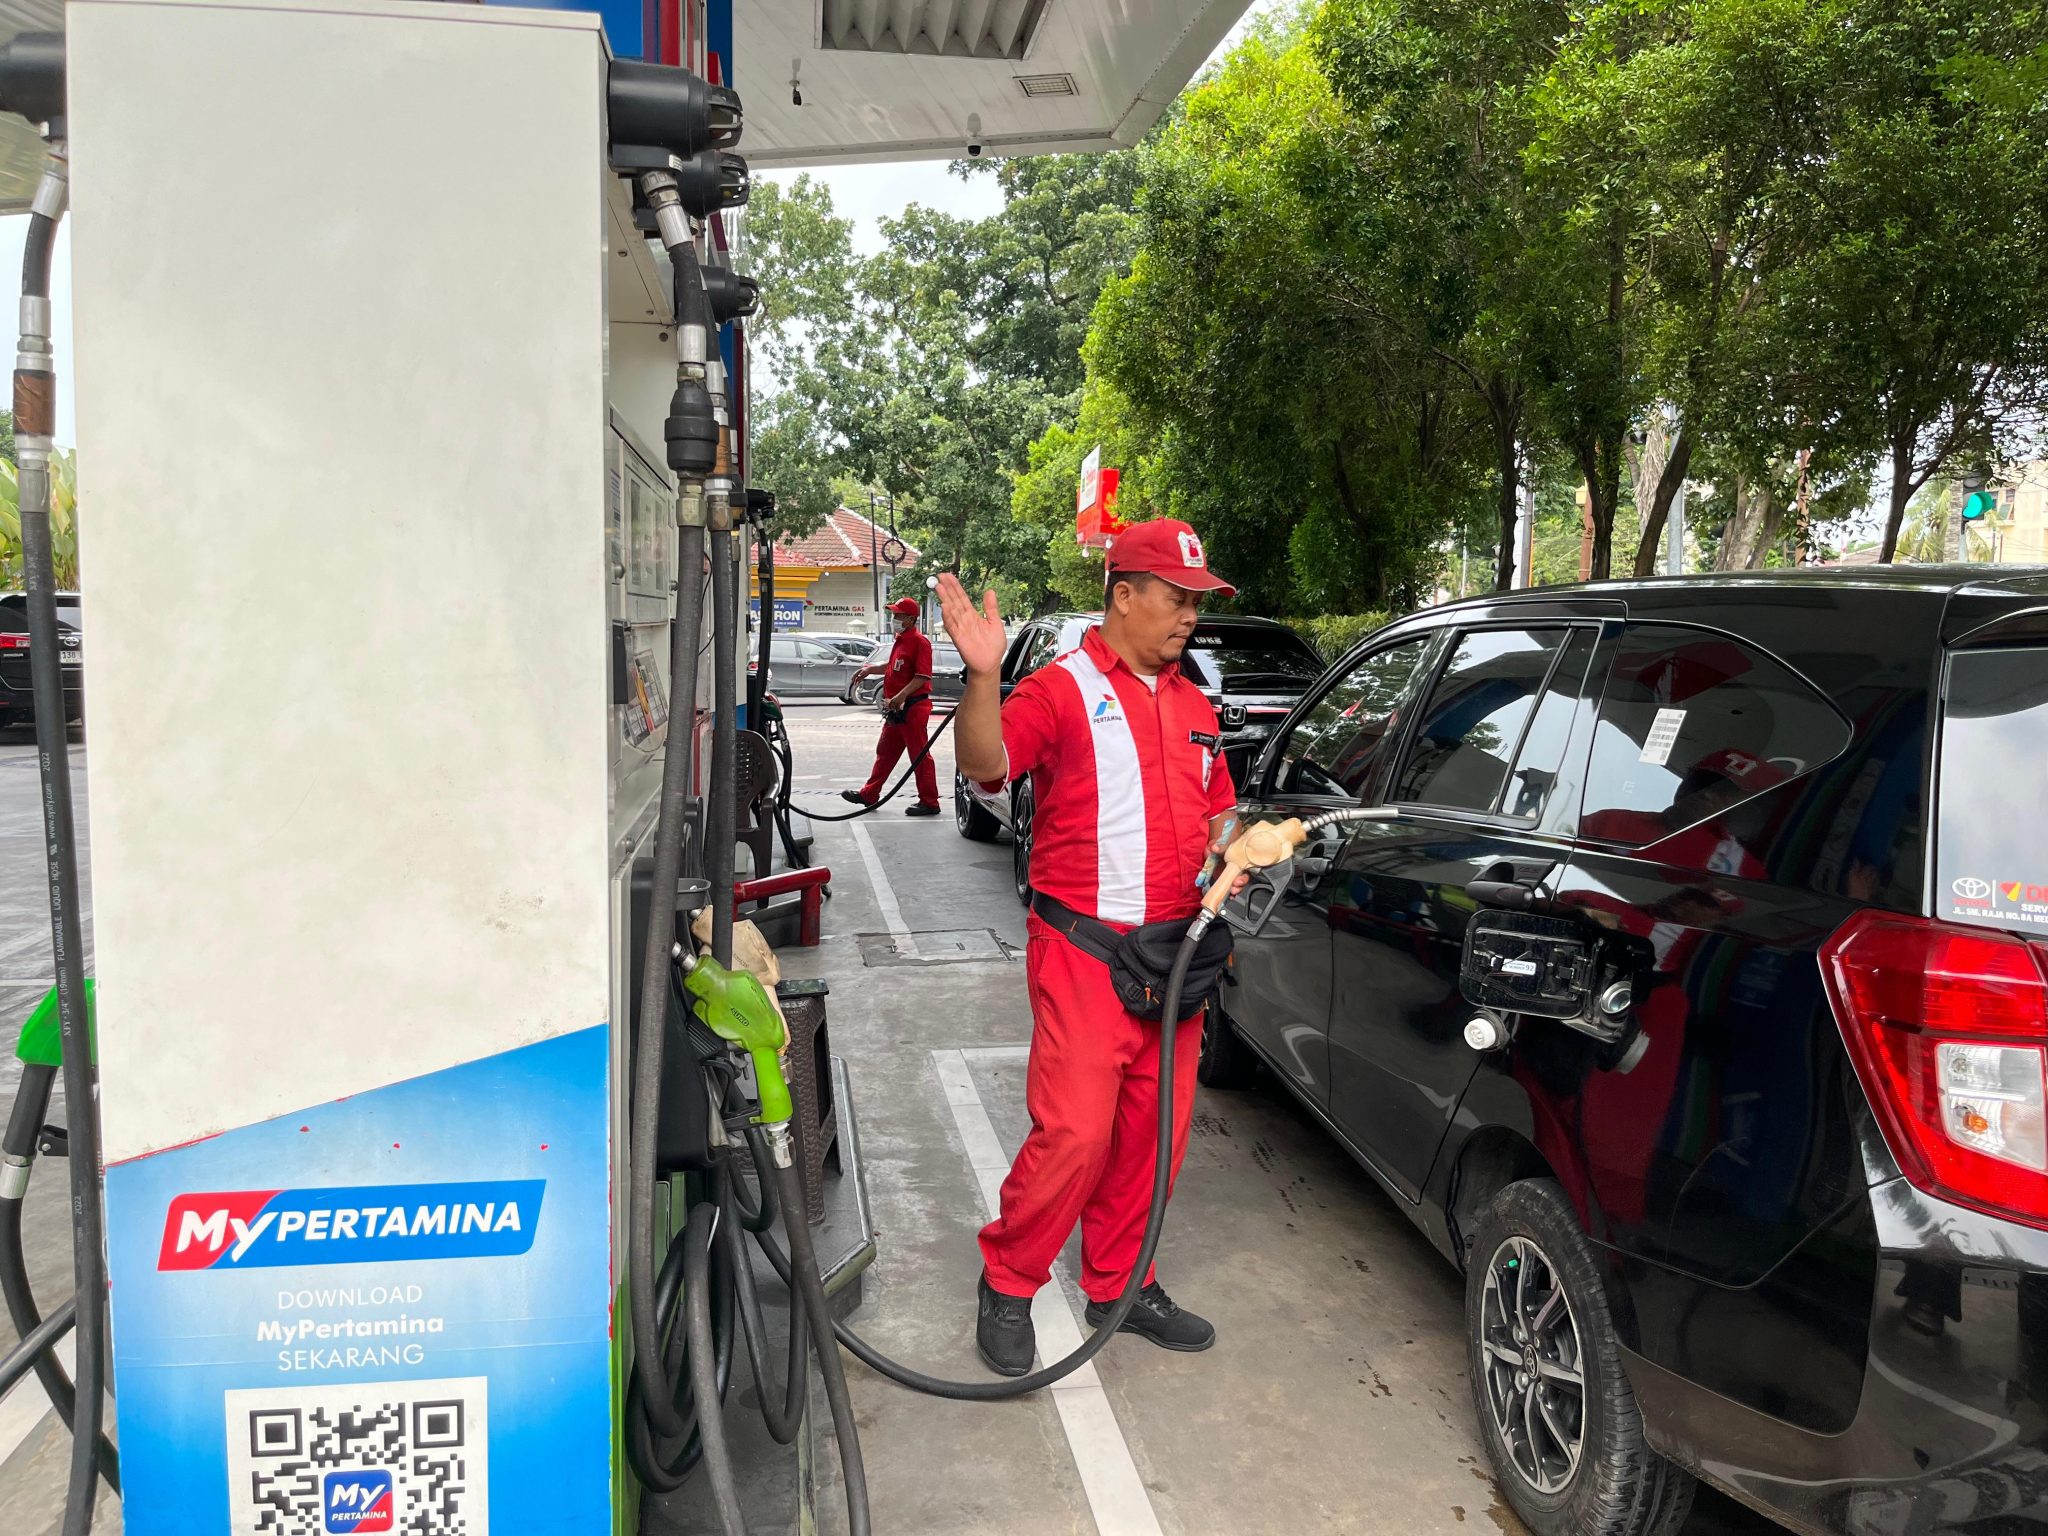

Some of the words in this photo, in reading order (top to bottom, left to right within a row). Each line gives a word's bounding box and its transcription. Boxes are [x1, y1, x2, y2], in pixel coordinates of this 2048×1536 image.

[53, 885, 61, 911] LIQUID
[1982, 910, 2004, 918] RAJA
[55, 916, 65, 961] FLAMMABLE
[59, 966, 69, 995] (19mm)
[277, 1285, 423, 1310] DOWNLOAD
[256, 1313, 444, 1346] MyPertamina
[277, 1343, 425, 1371] SEKARANG
[331, 1482, 386, 1512] My
[331, 1511, 387, 1521] PERTAMINA
